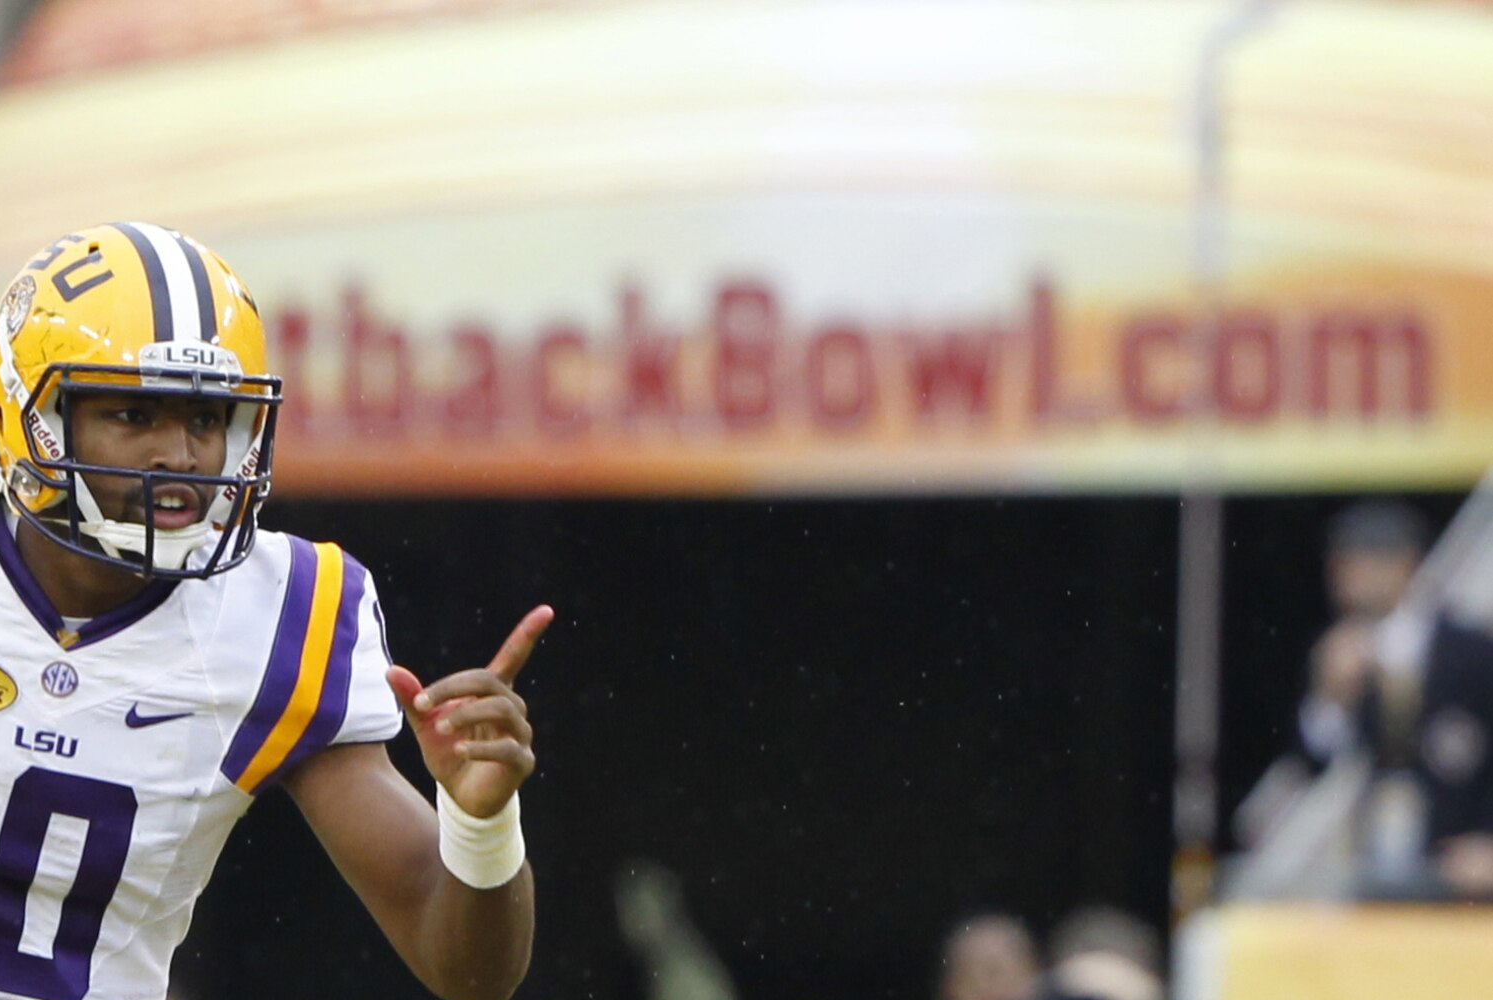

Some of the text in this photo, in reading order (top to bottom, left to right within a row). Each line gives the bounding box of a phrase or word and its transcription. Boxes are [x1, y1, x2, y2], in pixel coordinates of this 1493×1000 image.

[27, 234, 114, 303] SU
[166, 346, 215, 366] LSU
[276, 278, 1436, 432] tbackBowl.com
[14, 725, 79, 759] LSU
